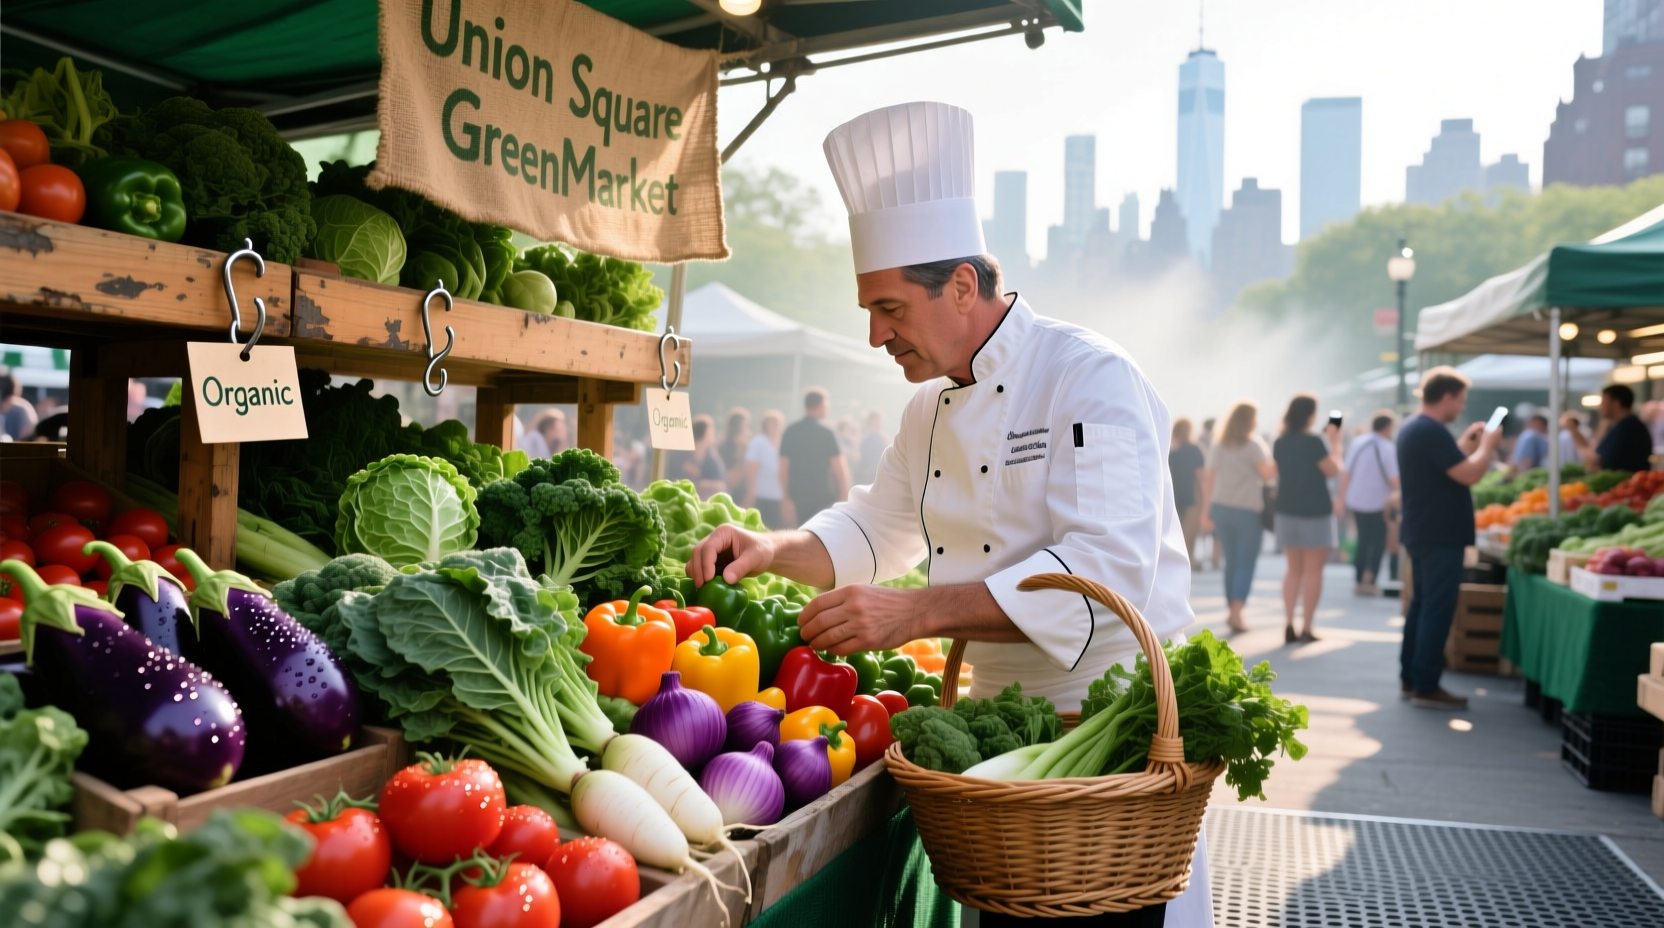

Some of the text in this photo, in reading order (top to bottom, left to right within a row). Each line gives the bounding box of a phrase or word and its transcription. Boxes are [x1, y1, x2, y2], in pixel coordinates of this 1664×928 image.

[420, 0, 682, 147] Union Square
[441, 87, 679, 216] GreenMarket
[202, 375, 294, 416] Organic
